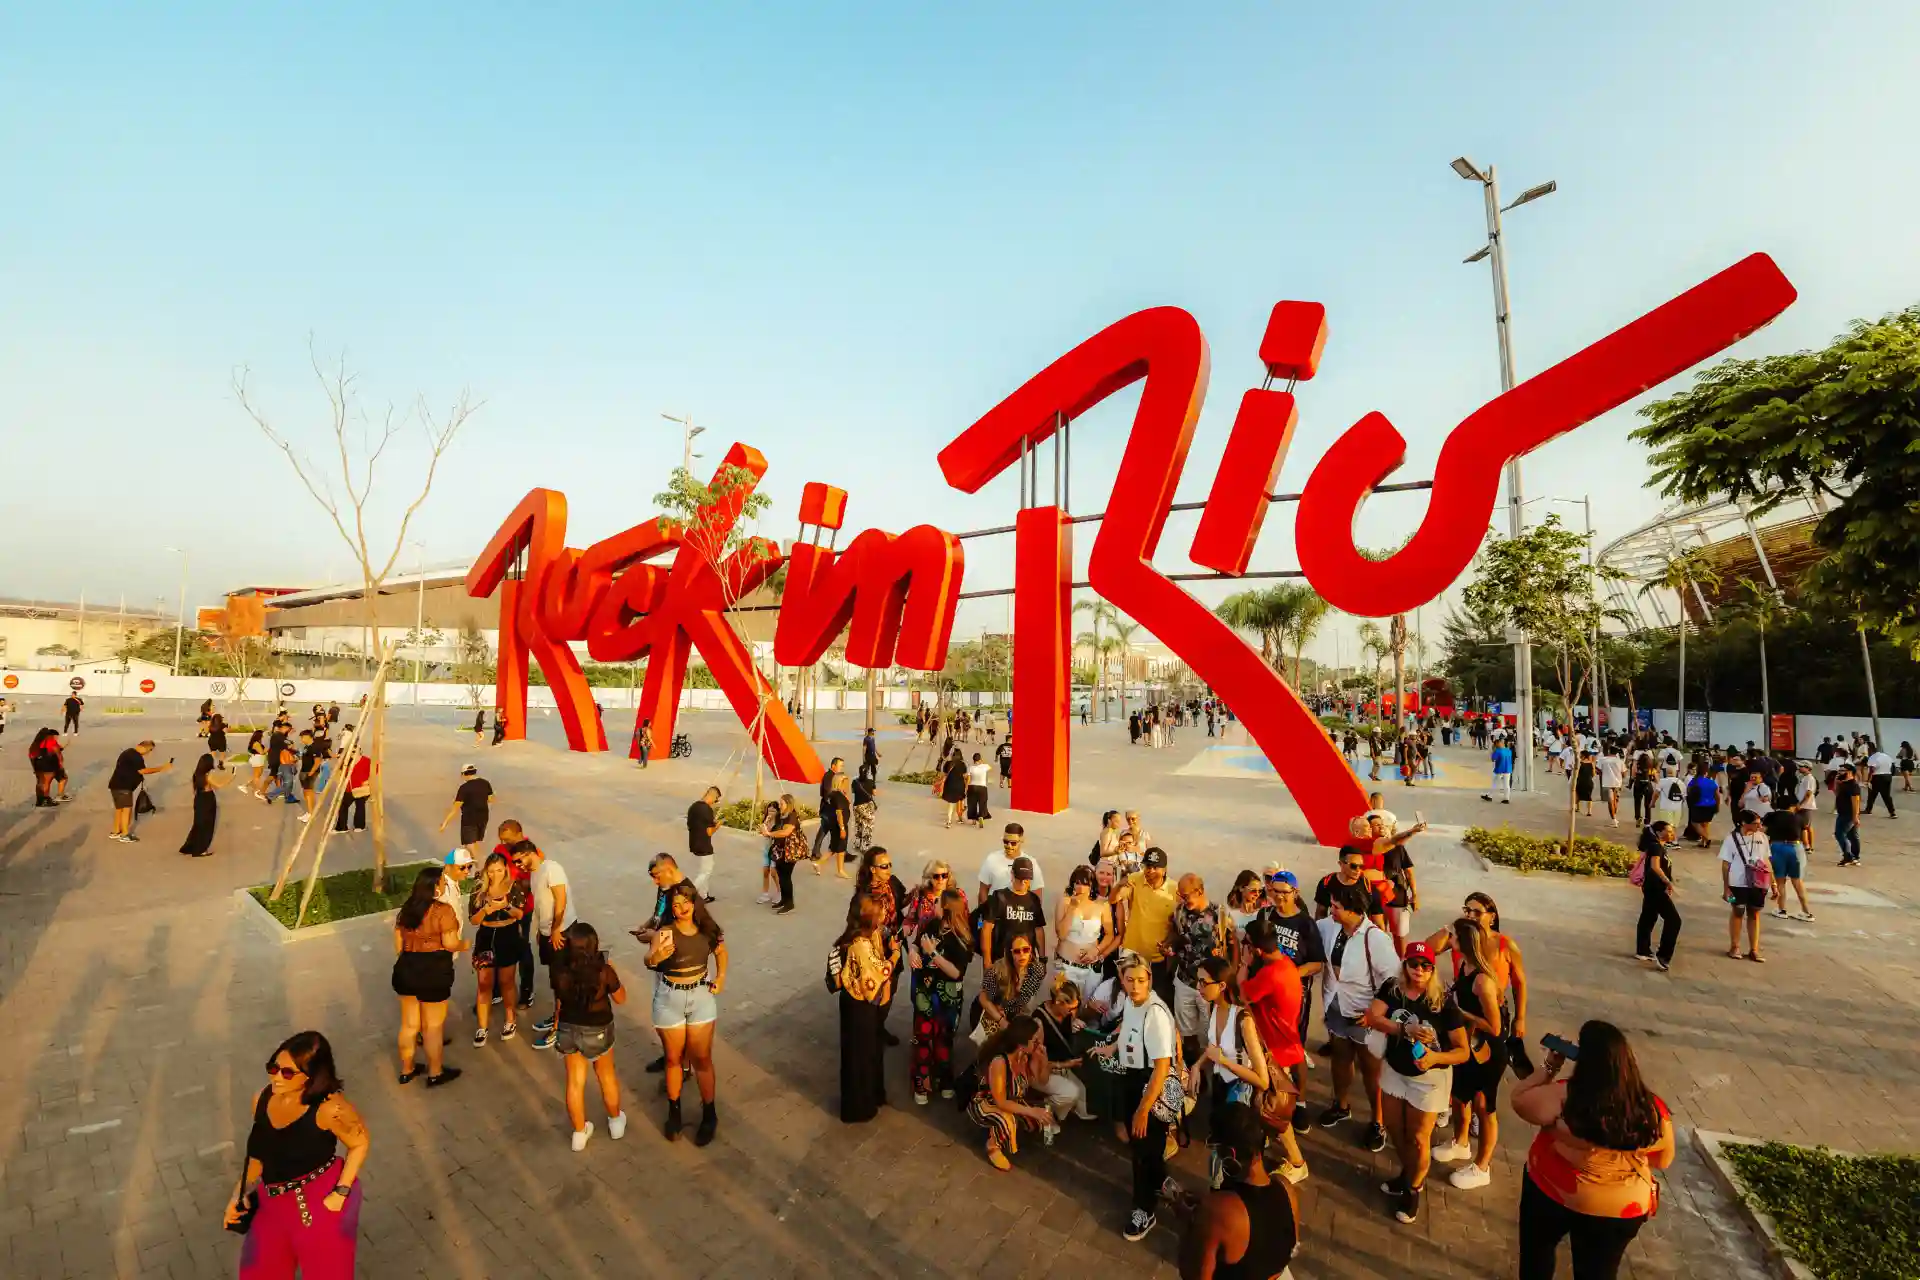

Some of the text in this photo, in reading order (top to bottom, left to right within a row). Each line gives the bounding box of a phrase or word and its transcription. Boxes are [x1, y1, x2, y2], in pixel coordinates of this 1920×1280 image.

[774, 481, 965, 671] in
[937, 251, 1798, 848] Rio
[1006, 905, 1034, 923] BEATLES
[1274, 924, 1300, 940] UBLE
